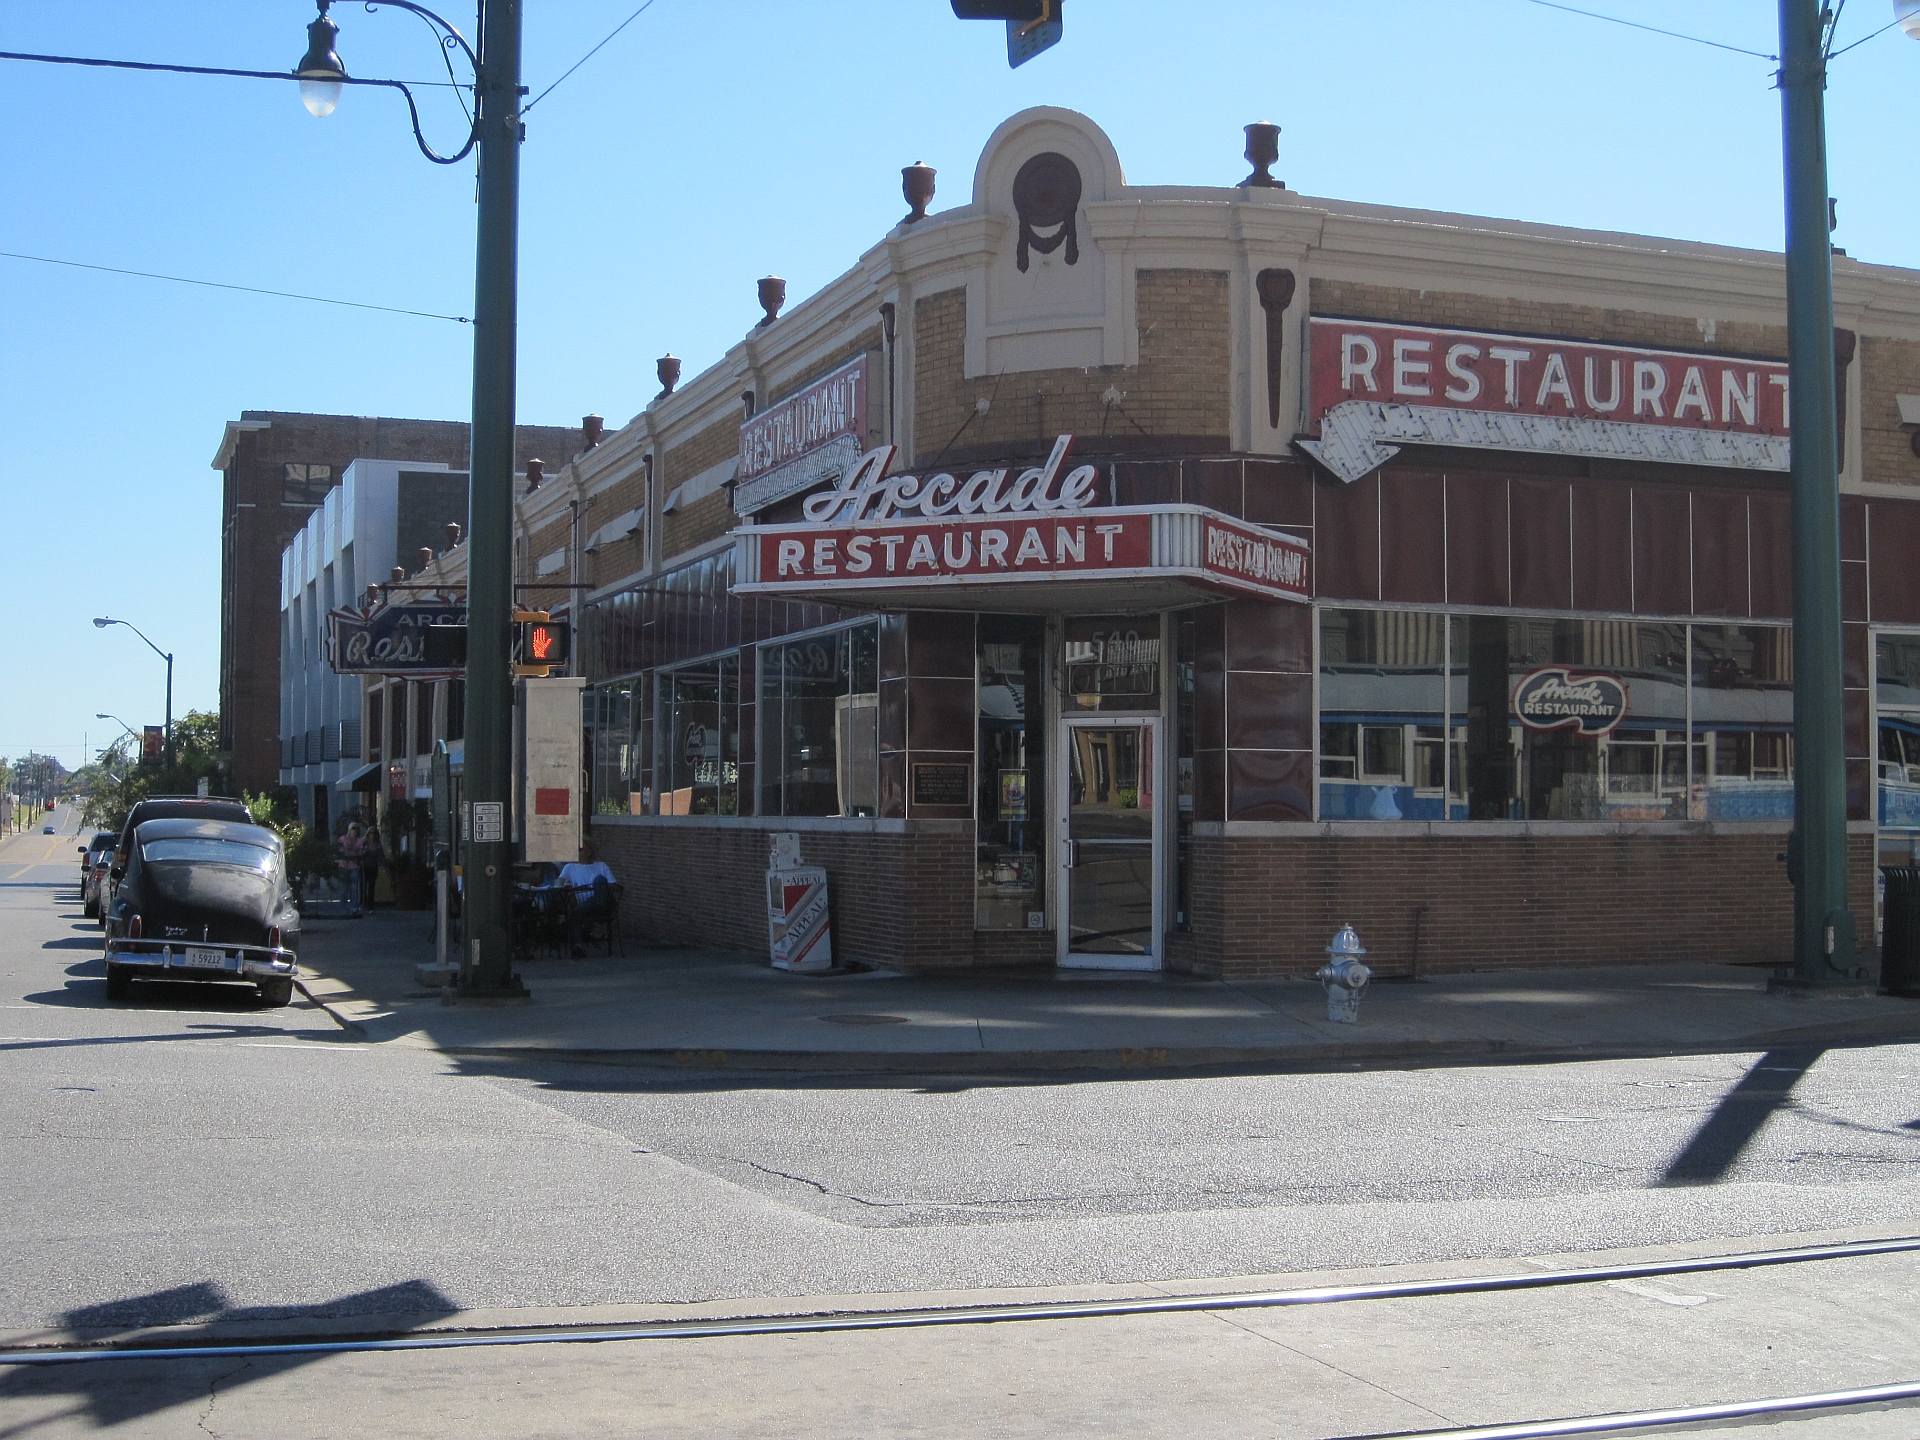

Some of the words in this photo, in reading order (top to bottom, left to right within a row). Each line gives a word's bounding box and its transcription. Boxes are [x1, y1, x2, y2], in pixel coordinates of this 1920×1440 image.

[1341, 333, 1790, 428] RESTAURANT
[803, 434, 1098, 521] Arcade
[778, 523, 1123, 576] RESTAURANT
[1208, 526, 1307, 587] RESTAURANT
[1090, 630, 1140, 654] 540
[1523, 702, 1615, 716] RESTAURANT
[1527, 678, 1604, 705] Arcade
[198, 954, 222, 964] 59212
